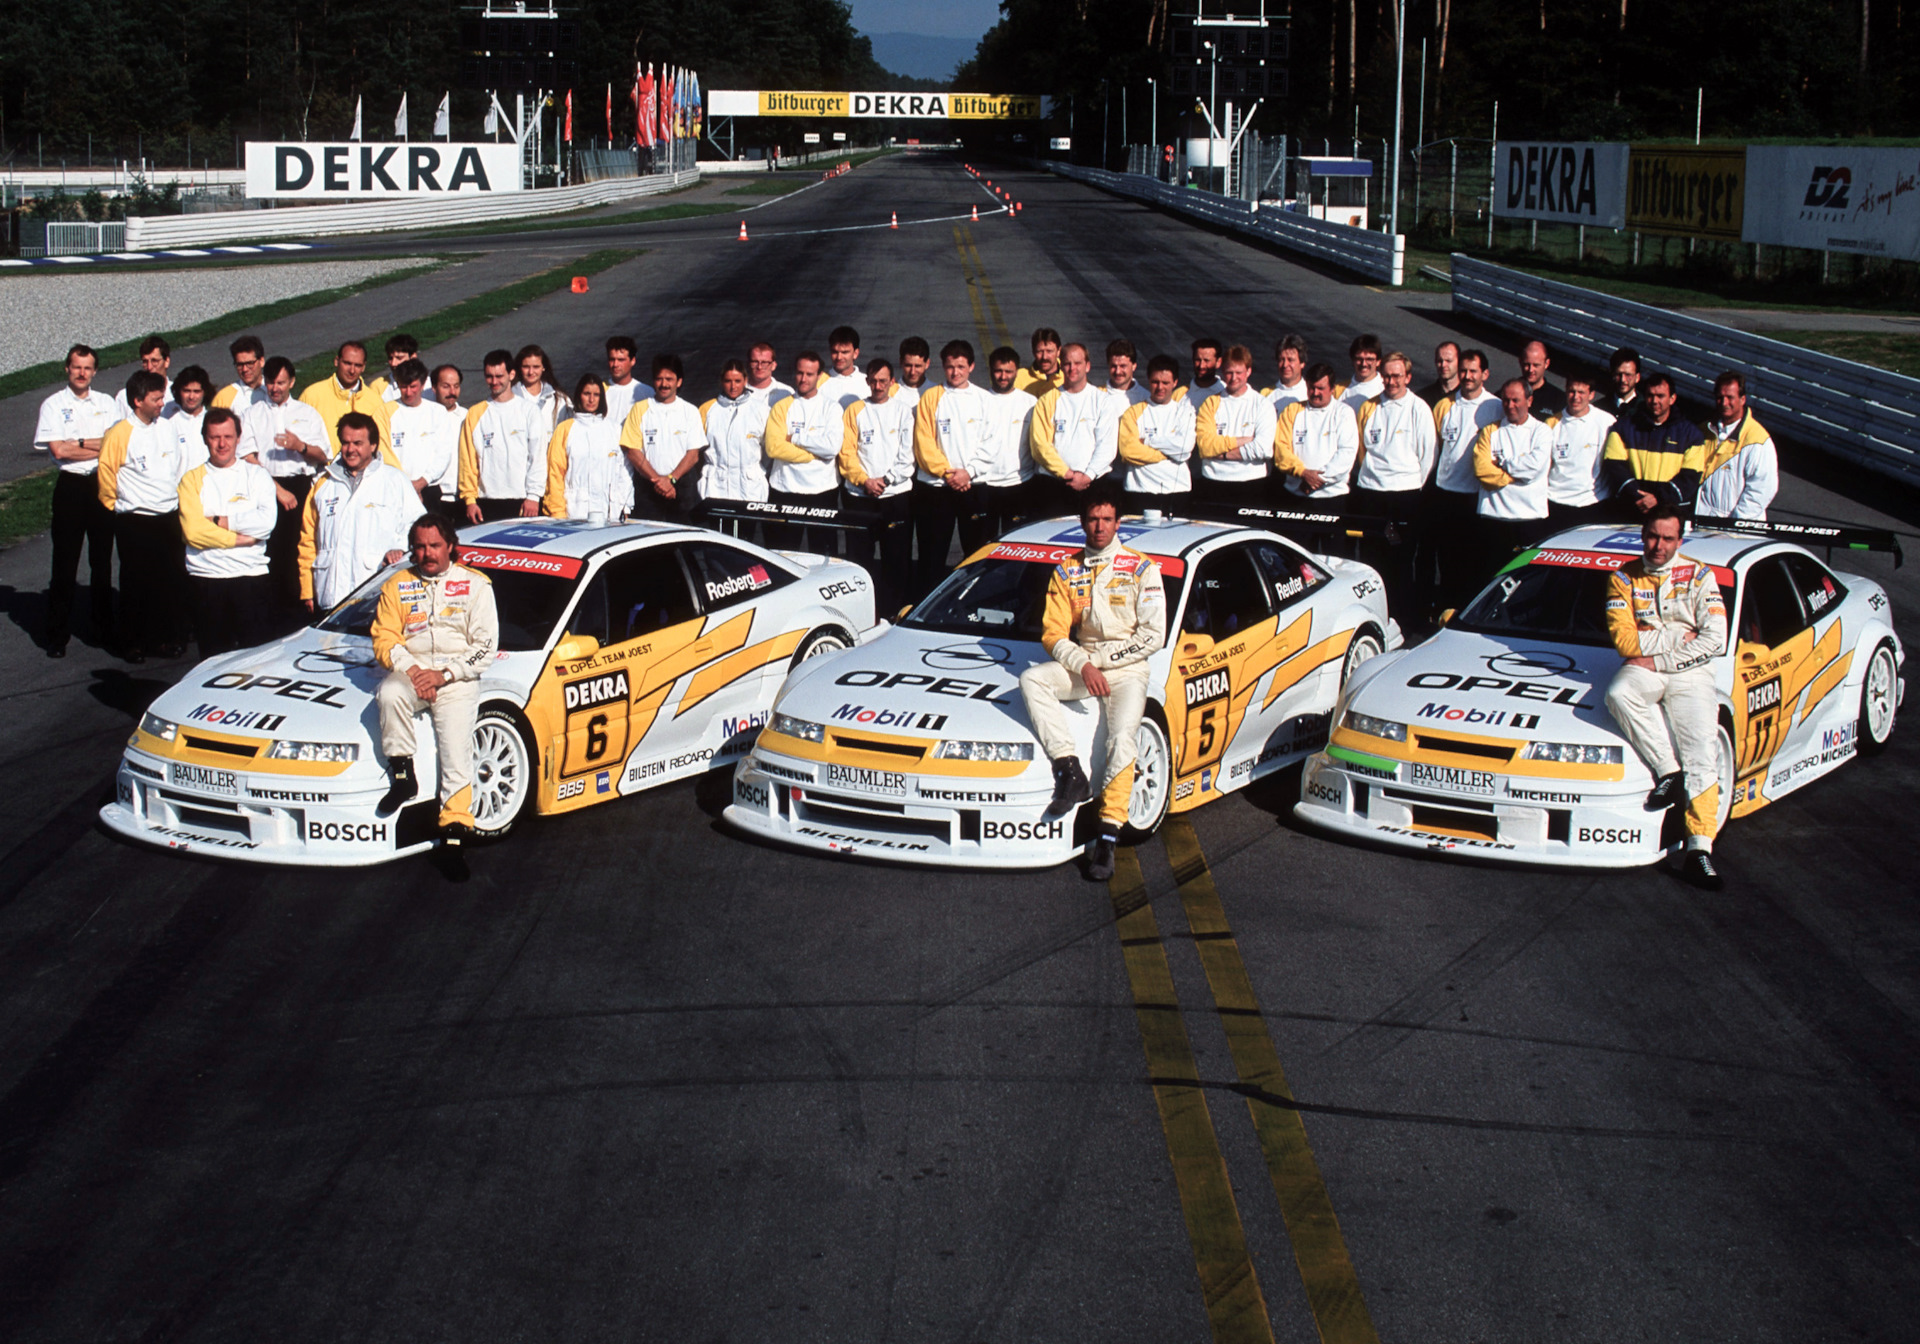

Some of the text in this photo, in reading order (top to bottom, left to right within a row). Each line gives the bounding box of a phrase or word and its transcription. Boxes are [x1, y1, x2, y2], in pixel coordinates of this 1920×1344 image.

[854, 95, 946, 115] DEKRA
[275, 146, 491, 191] DEKRA
[1507, 146, 1597, 216] DEKRA
[1804, 166, 1852, 209] D2
[746, 502, 838, 518] OPEL TEAM JOEST
[1237, 508, 1340, 523] OPEL TEAM JOEST
[1734, 521, 1841, 536] OPEL TEAM JOEST
[462, 551, 562, 572] Car Systems
[990, 545, 1046, 561] Philips
[1533, 551, 1626, 568] Philips Ca
[705, 573, 757, 601] Rosberg
[819, 581, 857, 600] OPEL
[1275, 576, 1304, 600] Reuter
[1352, 580, 1376, 599] OPEL
[570, 643, 653, 674] OPEL TEAM JOEST
[1110, 644, 1145, 662] OPEL
[1189, 643, 1247, 674] OPEL TEAM JOEST
[1676, 654, 1710, 671] OPEL
[1749, 667, 1767, 680] OPEL
[202, 673, 347, 709] OPEL
[564, 673, 629, 709] DEKRA
[834, 670, 1010, 705] OPEL
[1186, 671, 1229, 705] DEKRA
[1406, 673, 1595, 710] OPEL
[1748, 680, 1781, 713] DEKRA
[186, 703, 260, 727] Mobil
[722, 710, 768, 738] Mobil
[831, 703, 916, 727] Mobil
[1417, 703, 1507, 726] Mobil
[586, 713, 608, 761] 6
[1198, 706, 1216, 759] 5
[1822, 723, 1852, 750] Mobil
[721, 740, 756, 757] MICH
[1792, 755, 1819, 775] RECARO
[1820, 742, 1857, 765] MICHELIN
[629, 749, 714, 782] BILSTEIN RECARO
[761, 761, 815, 784] MICHELIN
[1230, 755, 1256, 779] BILSTEIN
[1346, 762, 1397, 781] MICHELIN
[251, 790, 329, 802] MICHELIN
[557, 779, 586, 801] BBS
[736, 778, 769, 808] BOSCH
[921, 789, 1006, 803] MICHELIN
[1175, 780, 1195, 801] BBS
[1308, 780, 1342, 805] BOSCH
[1511, 789, 1582, 804] MICHELIN
[148, 825, 260, 850] MICHELIN
[308, 821, 387, 842] BOSCH
[796, 826, 930, 852] MICHELIN
[983, 821, 1064, 839] BOSCH
[1377, 825, 1516, 849] MICHELIN
[1578, 827, 1642, 844] BOSCH
